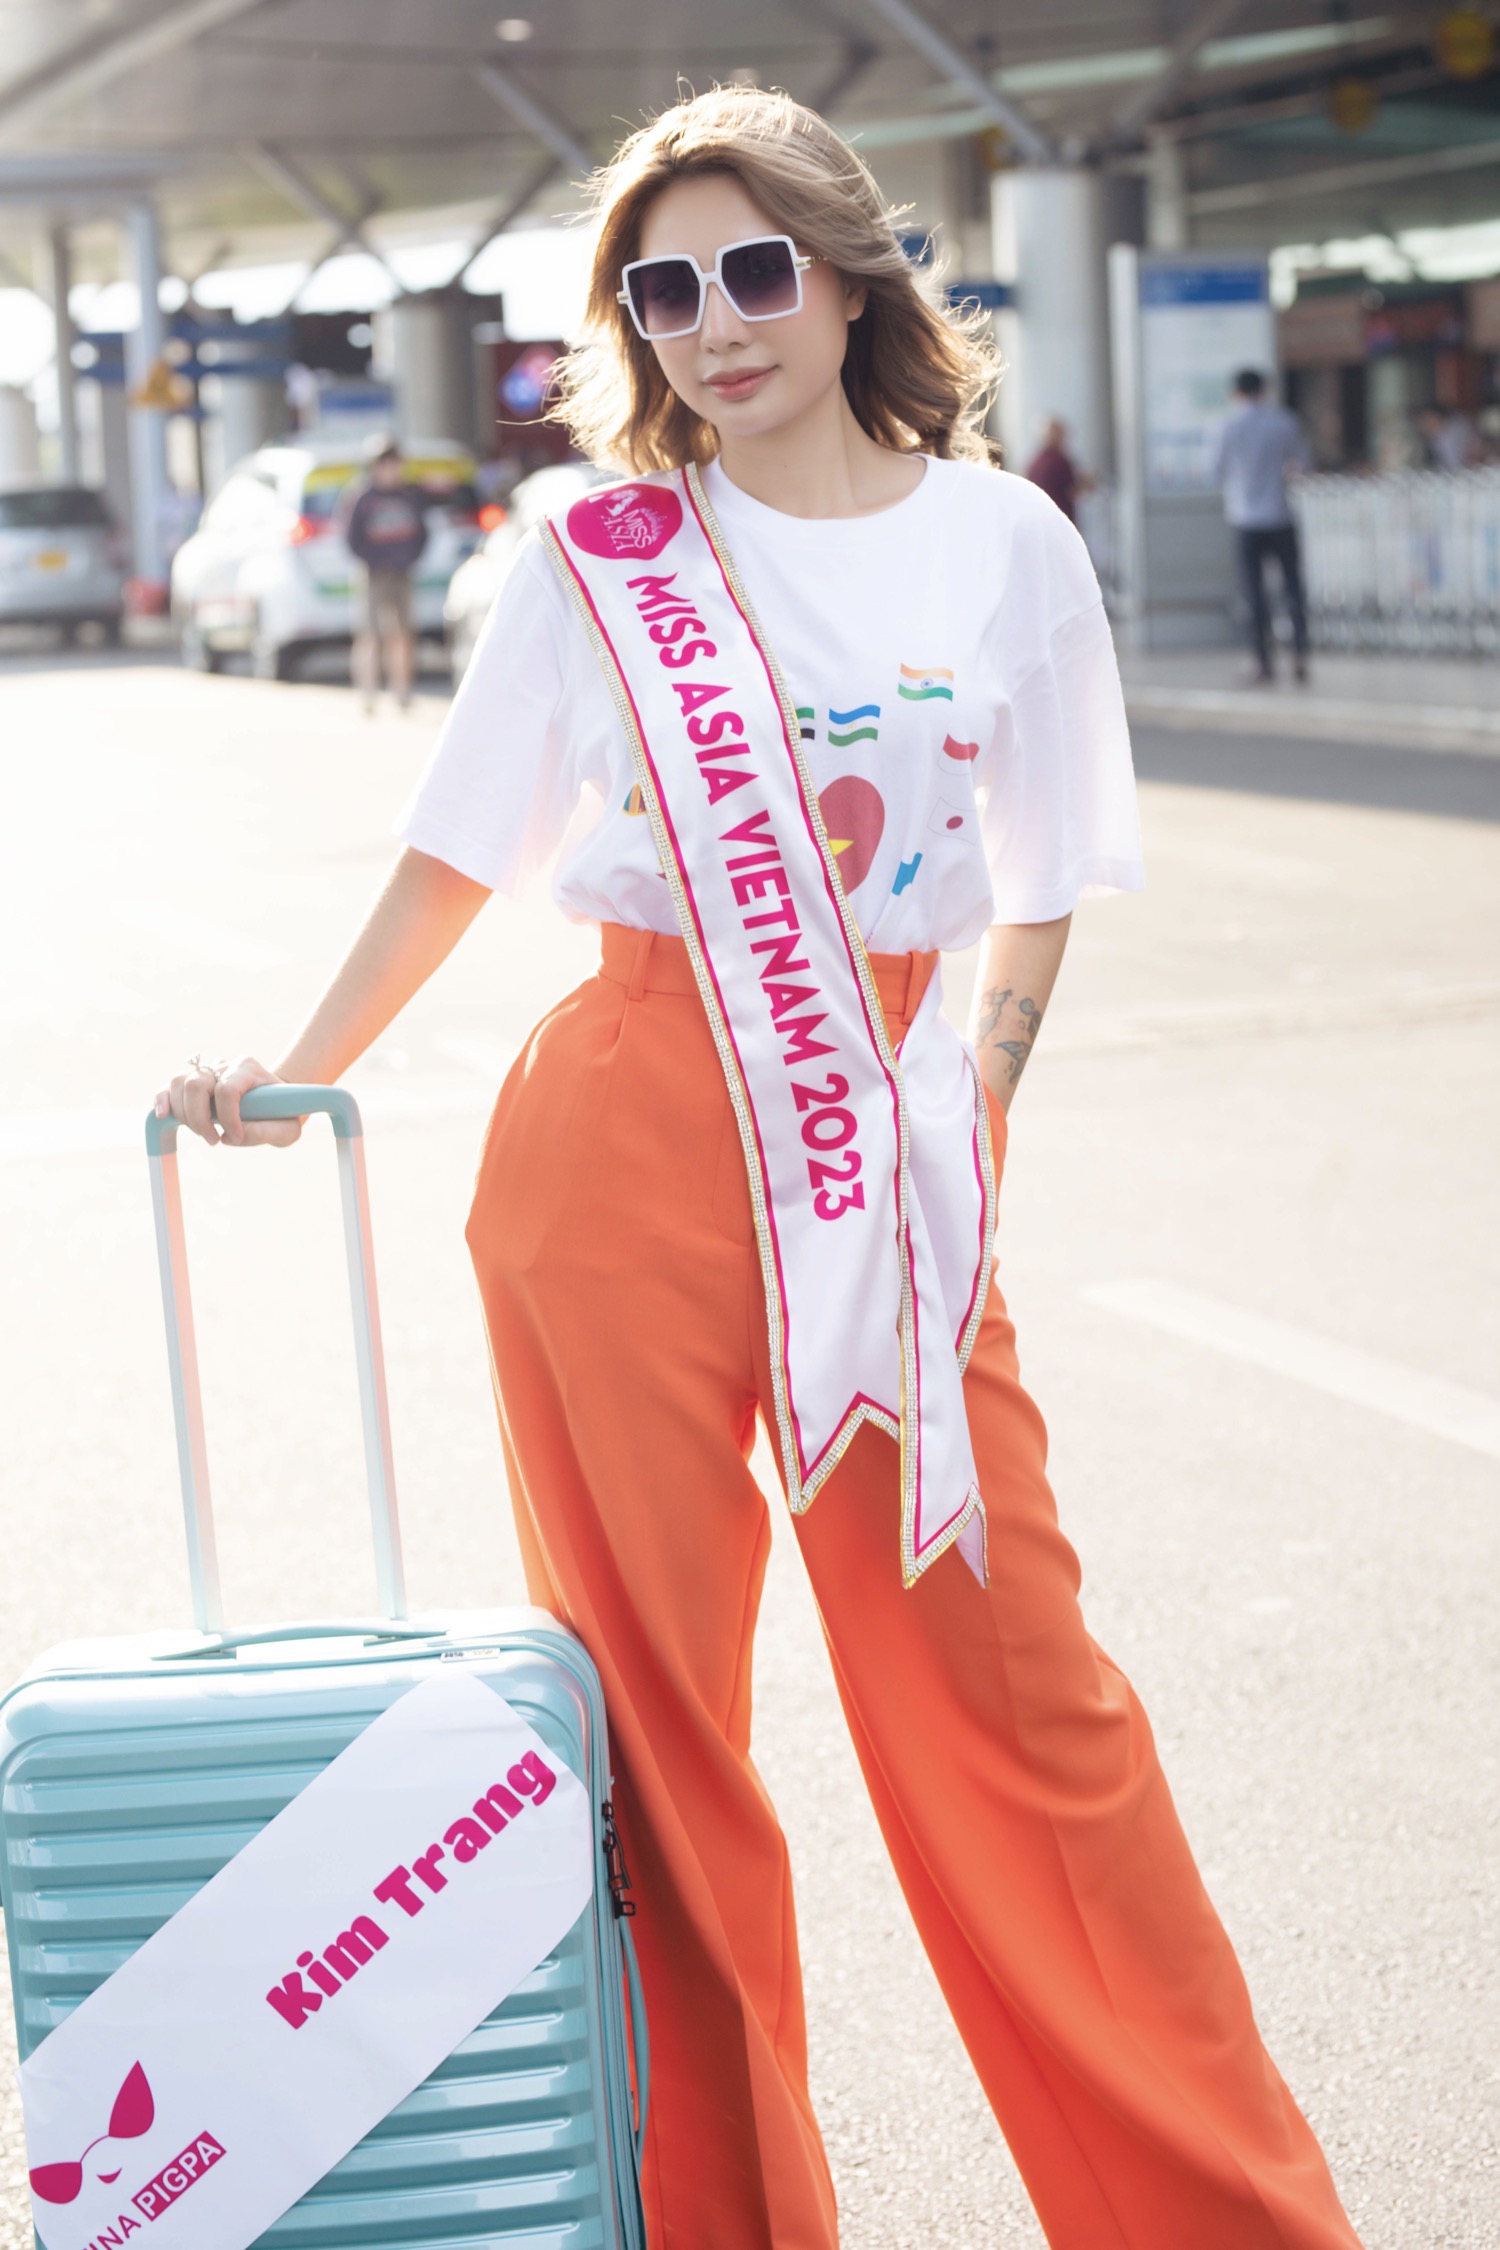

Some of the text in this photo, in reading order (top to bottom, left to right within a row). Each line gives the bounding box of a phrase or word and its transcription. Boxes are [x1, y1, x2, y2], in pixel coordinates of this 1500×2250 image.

[602, 516, 636, 551] ASIA
[622, 508, 653, 549] MISS
[625, 572, 867, 1223] MISS ASIA VIETNAM 2023
[265, 1750, 557, 2031] Kim Trang
[83, 2140, 222, 2250] NA PIGPA
